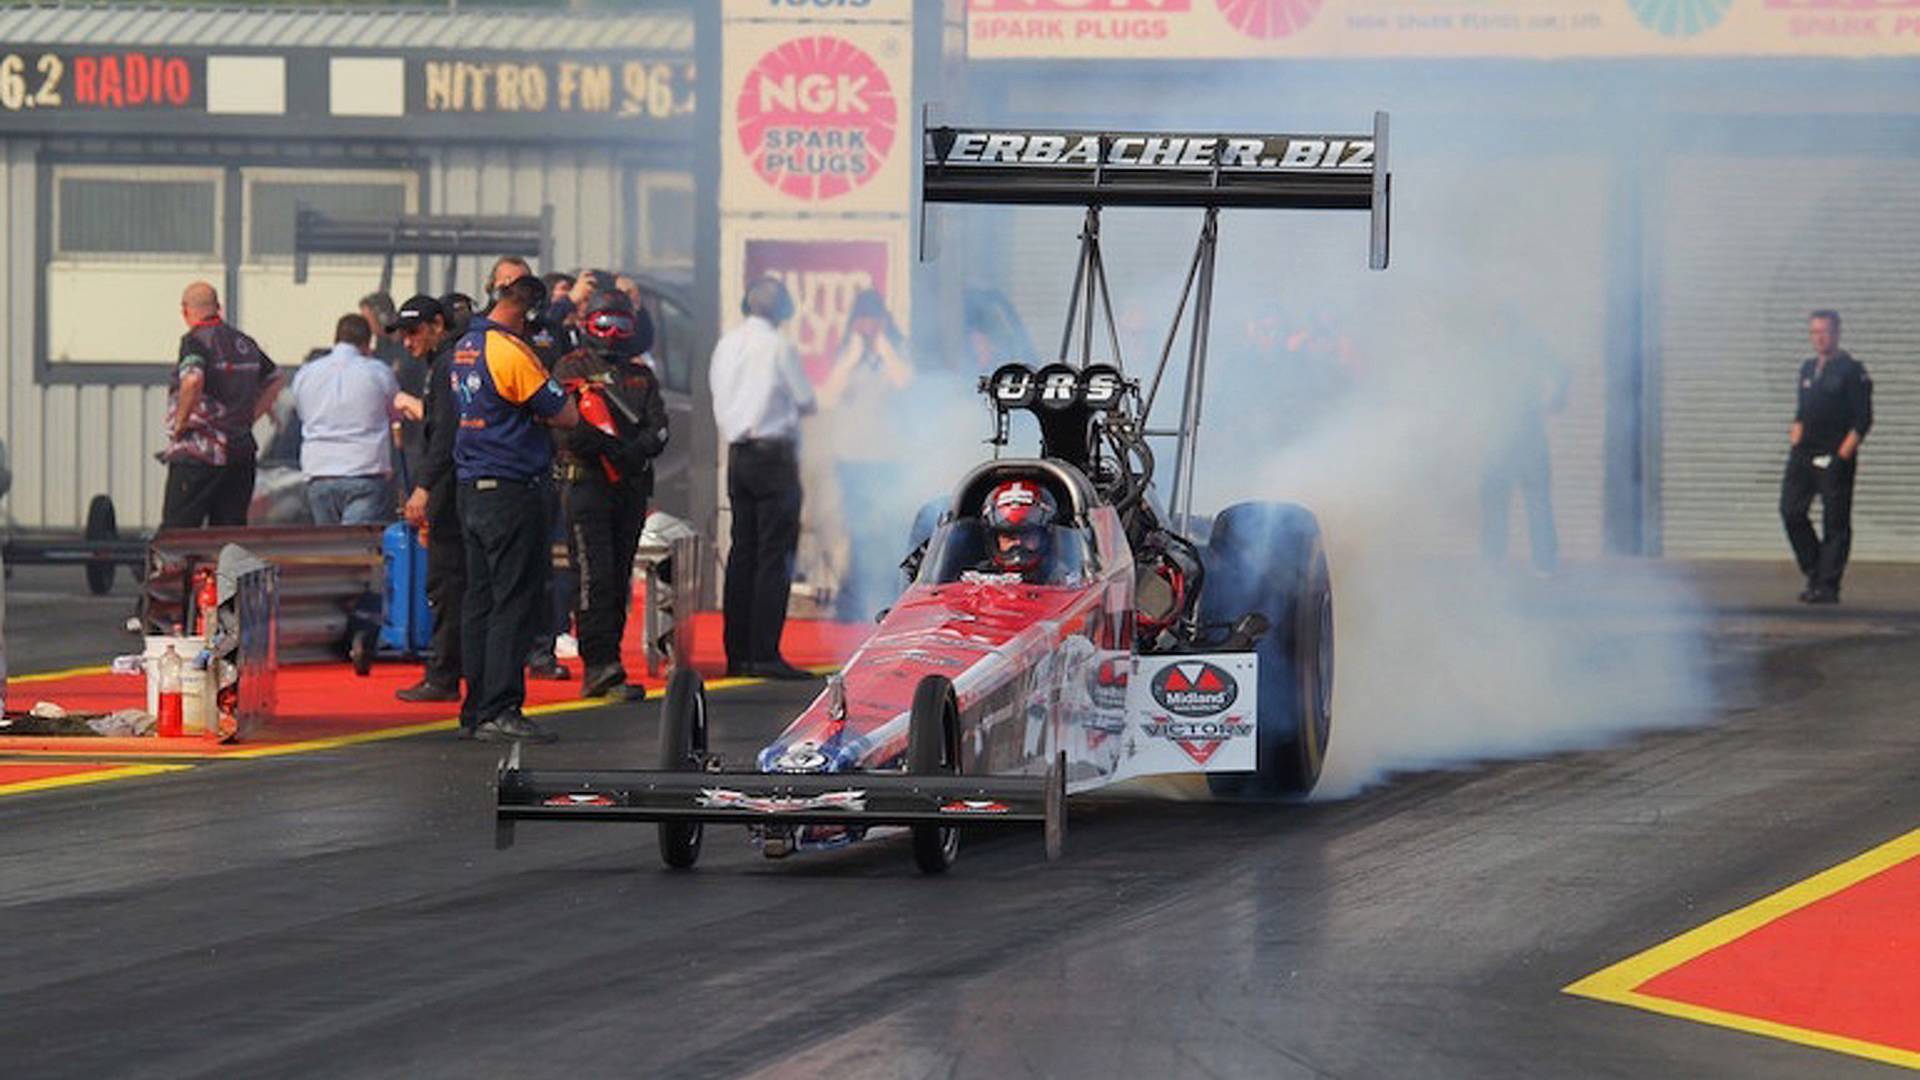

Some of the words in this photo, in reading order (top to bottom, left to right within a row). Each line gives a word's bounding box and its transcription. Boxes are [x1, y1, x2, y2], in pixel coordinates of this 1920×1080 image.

[974, 18, 1064, 40] SPARK
[1075, 18, 1169, 40] PLUGS
[74, 52, 191, 107] RADIO
[425, 61, 547, 112] NITRO
[557, 61, 612, 112] FM
[760, 74, 870, 113] NGK
[765, 129, 865, 149] SPARK
[948, 132, 1375, 169] ERBACHER.BIZ
[765, 153, 866, 174] PLUGS
[1165, 692, 1226, 704] Midland
[1140, 721, 1253, 738] VICTORY
